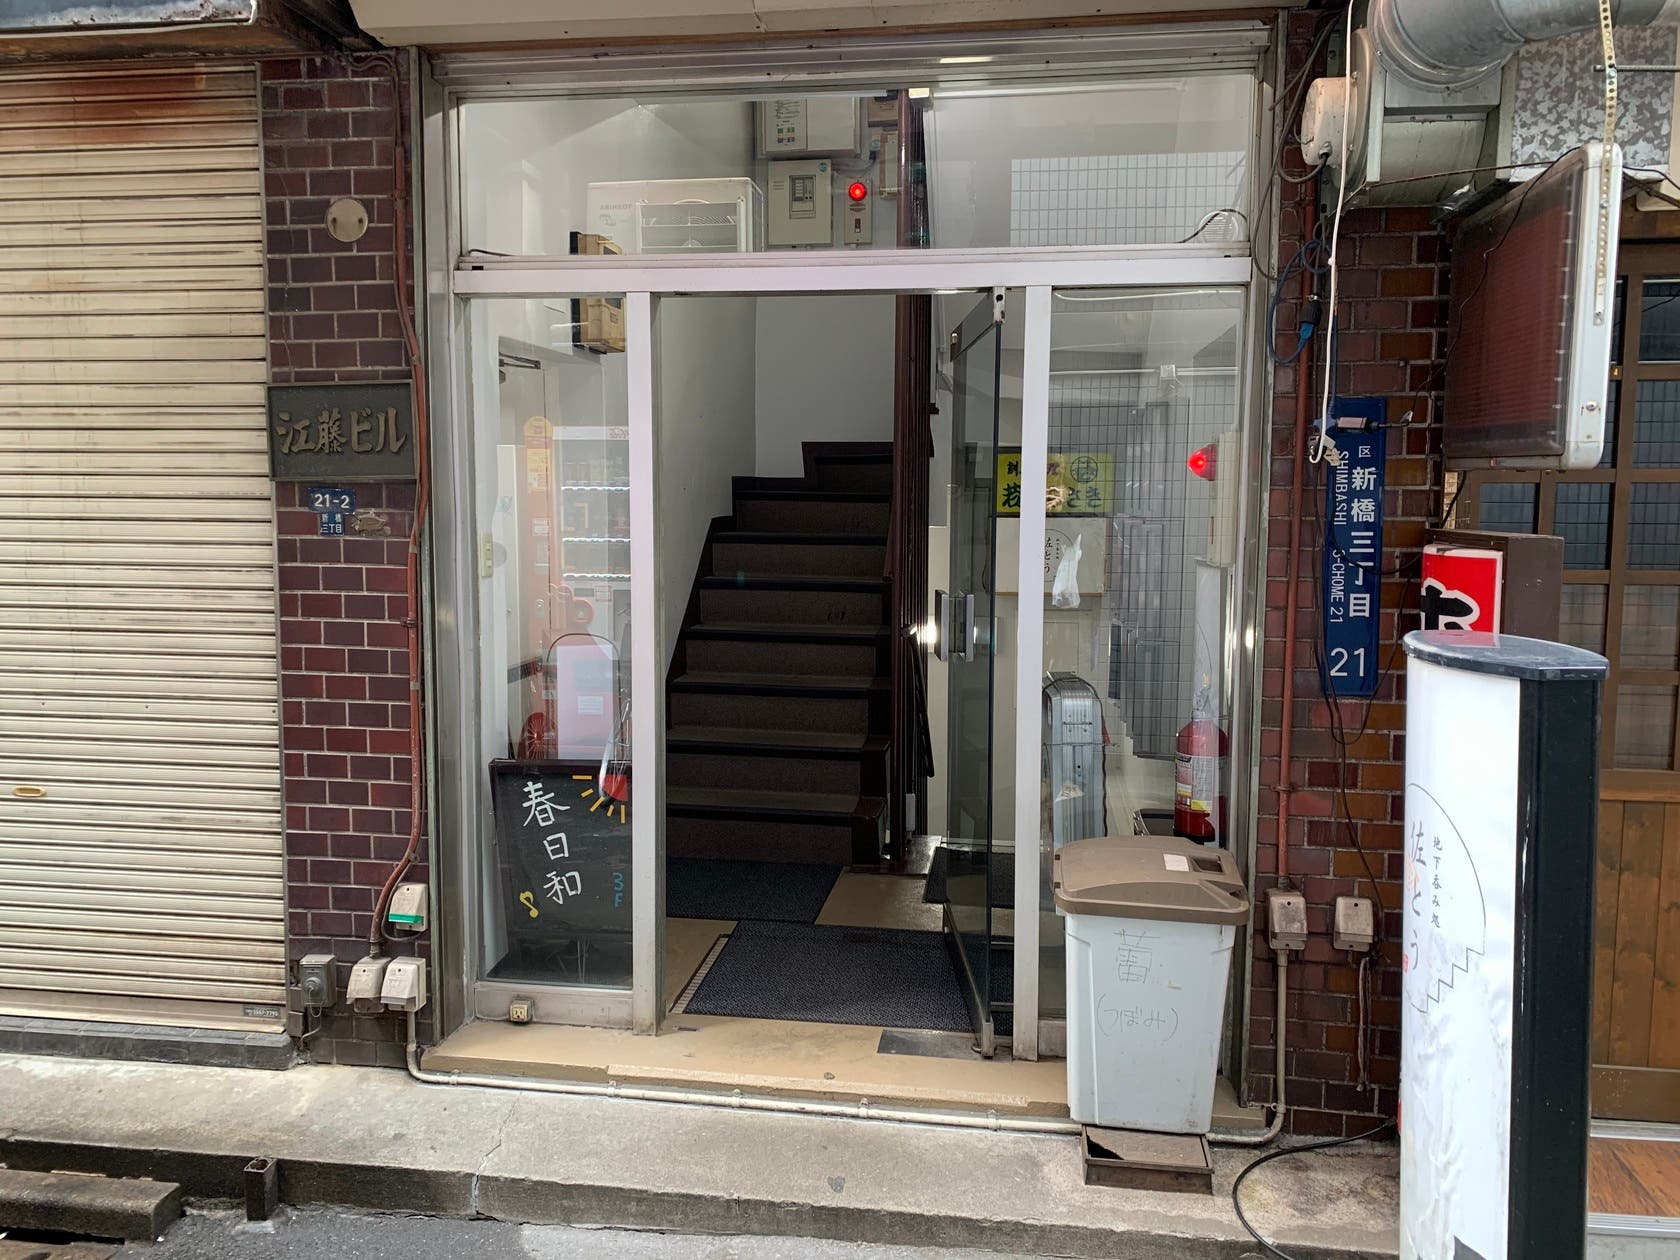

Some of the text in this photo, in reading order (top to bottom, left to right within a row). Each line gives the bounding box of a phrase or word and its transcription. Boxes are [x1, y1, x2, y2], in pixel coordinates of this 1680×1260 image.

[276, 407, 407, 454] 江藤ビル
[314, 493, 350, 509] 21-2
[321, 523, 342, 534] 三丁目
[1329, 450, 1350, 624] SHIMBASHI 3-CHOME 21
[1349, 466, 1377, 618] 新橋三丁目
[1330, 647, 1365, 677] 21
[522, 781, 581, 905] 春日和
[612, 872, 625, 909] 3F
